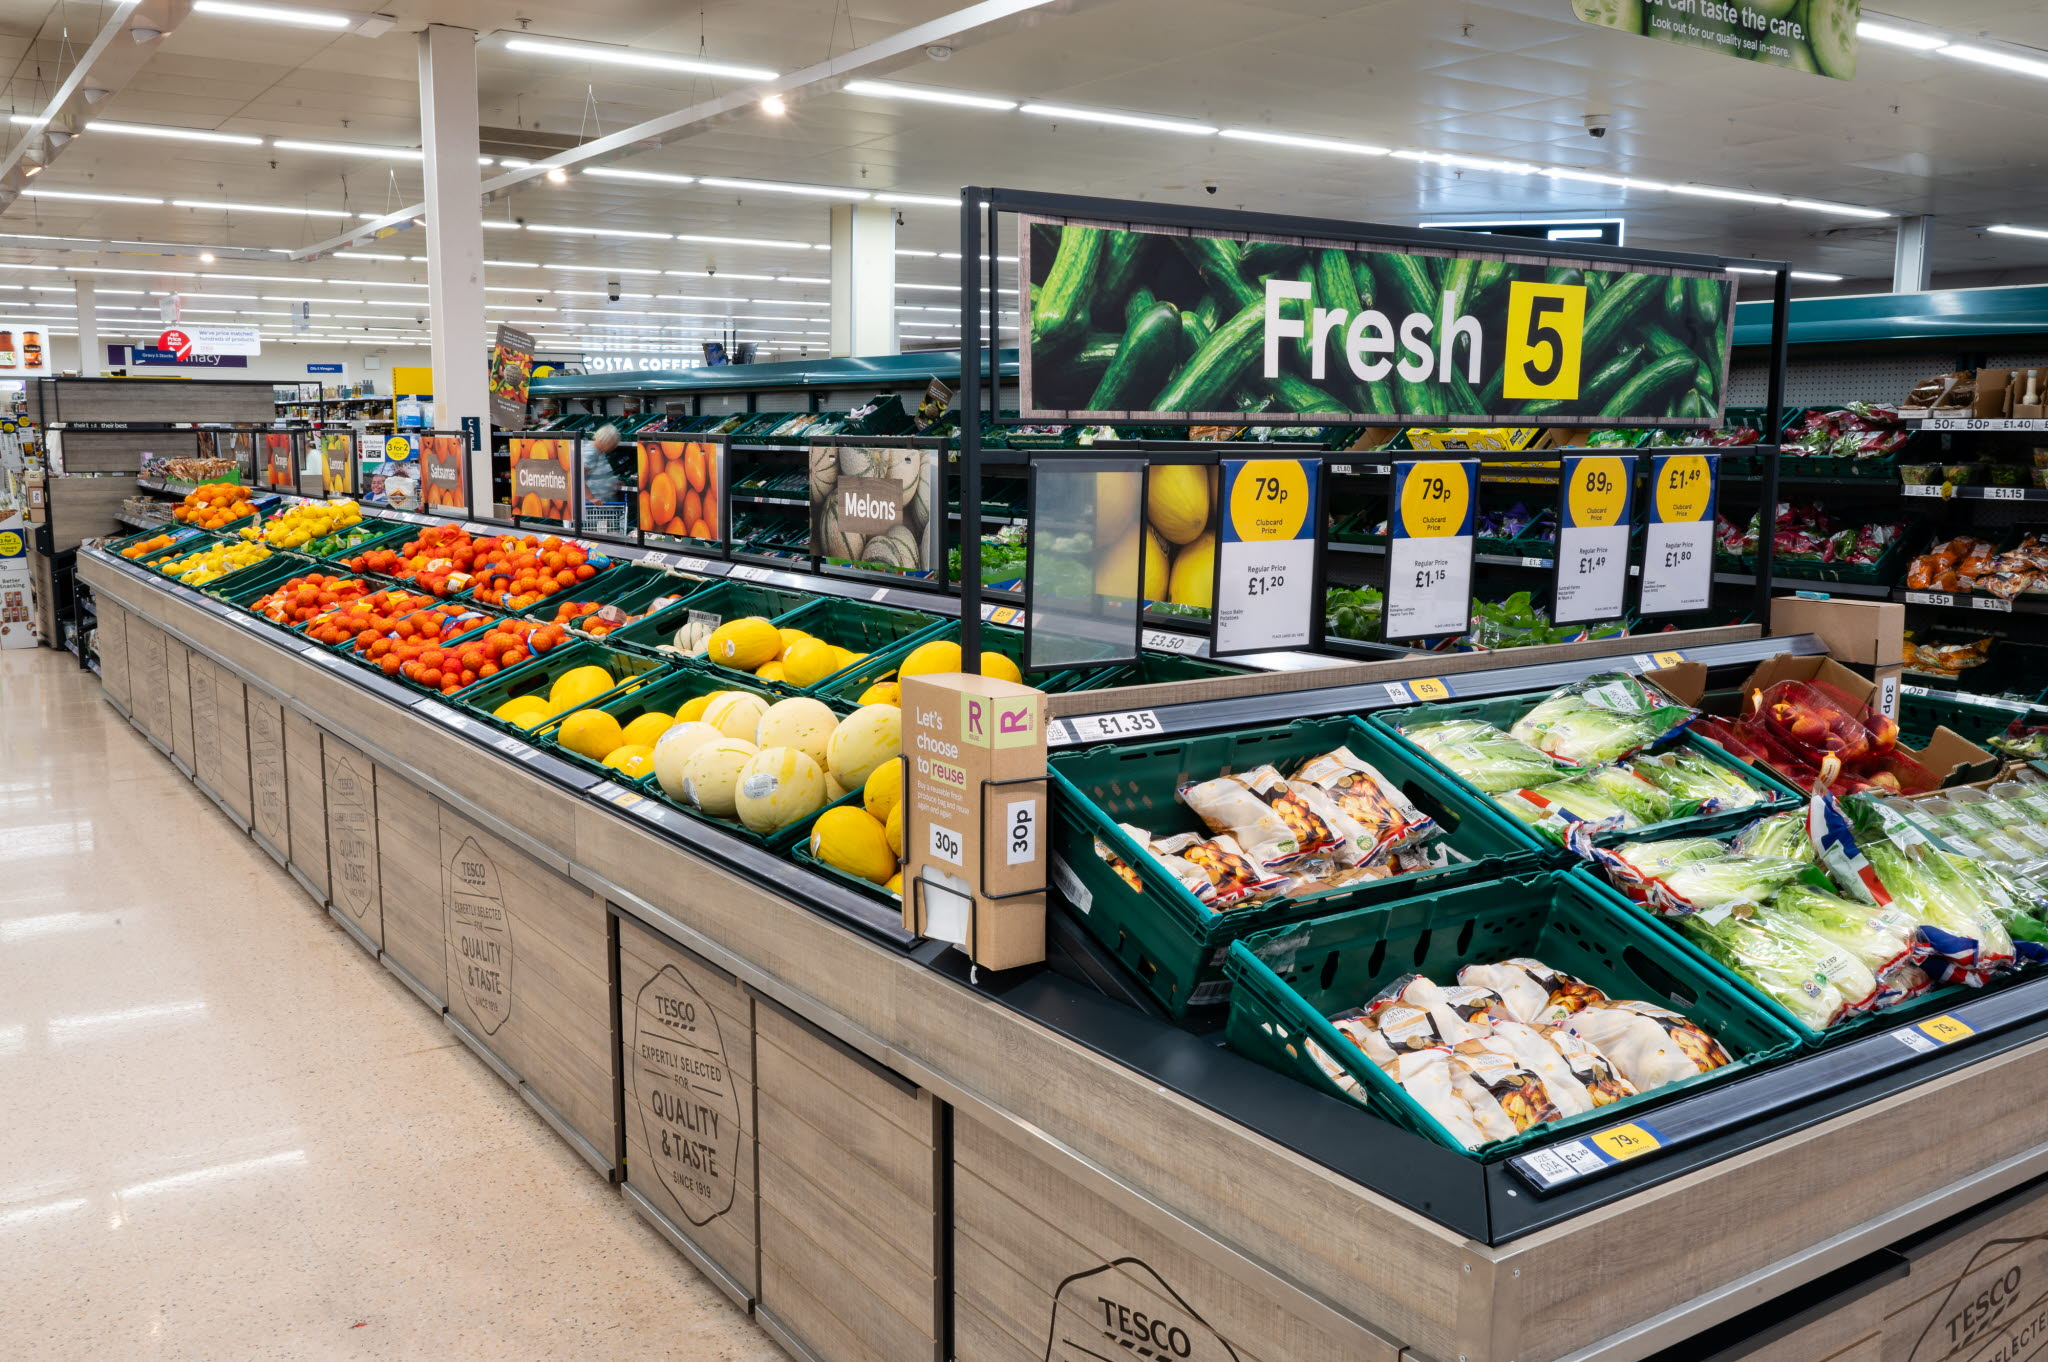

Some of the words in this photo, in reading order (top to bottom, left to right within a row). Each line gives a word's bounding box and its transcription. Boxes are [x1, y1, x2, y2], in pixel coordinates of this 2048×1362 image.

[1668, 0, 1695, 14] can
[1701, 1, 1738, 25] taste
[1742, 8, 1766, 31] the
[1769, 17, 1806, 41] care.
[1652, 15, 1672, 30] Look
[1673, 21, 1687, 34] out
[1688, 23, 1700, 37] for
[1701, 29, 1715, 41] our
[1716, 30, 1742, 49] quality
[1743, 38, 1758, 51] seal
[1759, 40, 1791, 58] in-store.
[1263, 279, 1483, 385] Fresh
[1522, 295, 1565, 387] 5
[583, 357, 634, 372] COSTA
[638, 358, 701, 371] COFFEE
[1967, 420, 1990, 430] 50p
[2004, 420, 2031, 429] £1.40
[366, 450, 381, 458] F&F
[403, 443, 408, 451] 2
[329, 457, 344, 470] Lemons
[430, 464, 455, 480] Satsumas
[519, 469, 566, 490] Clementines
[1586, 472, 1613, 494] 89p
[1669, 469, 1701, 490] £1.49
[1255, 477, 1288, 504] 79p
[1422, 478, 1451, 502] 79p
[1995, 489, 2022, 499] £1.15
[844, 492, 896, 521] Melons
[1586, 507, 1607, 515] Clubcard
[1673, 503, 1692, 511] Clubcard
[1256, 518, 1283, 526] Clubcard
[1422, 516, 1446, 524] Clubcard
[1248, 565, 1269, 573] Regular
[1271, 564, 1286, 572] Price
[1579, 557, 1606, 574] £1.49
[1665, 551, 1692, 568] £1.80
[1248, 576, 1284, 596] £1.20
[1415, 569, 1446, 588] £1.15
[1928, 594, 1950, 605] 55p
[1148, 633, 1185, 650] £3.50
[1420, 683, 1438, 693] 69p
[1884, 685, 1894, 714] 30p
[916, 706, 943, 731] Let's
[969, 700, 983, 735] R
[1000, 707, 1028, 733] R
[1098, 713, 1156, 735] £1.35
[917, 732, 958, 759] choose
[917, 756, 930, 774] to
[932, 764, 964, 785] reuse
[917, 780, 926, 790] Buy
[930, 786, 950, 797] reusable
[917, 792, 937, 803] produce
[937, 797, 947, 808] bag
[947, 802, 956, 810] and
[930, 806, 939, 814] and
[1012, 809, 1032, 853] 30p
[935, 831, 958, 860] 30p
[461, 861, 485, 878] TESCO
[454, 901, 476, 916] EXPERTLY
[477, 906, 502, 921] SELECTED
[461, 936, 501, 966] QUALITY
[468, 965, 475, 986] &
[475, 967, 502, 995] TASTE
[655, 995, 696, 1023] TESCO
[642, 1044, 679, 1068] EXPERTLY
[681, 1056, 722, 1082] SELECTED
[674, 1074, 689, 1089] FOR
[652, 1090, 719, 1140] QUALITY
[1610, 1134, 1640, 1148] 79p
[662, 1129, 672, 1158] &
[673, 1133, 719, 1178] TASTE
[1533, 1154, 1551, 1165] 02E
[1564, 1148, 1589, 1164] £1.20
[1540, 1160, 1563, 1173] 01A
[673, 1171, 694, 1191] SINCE
[695, 1178, 711, 1198] 1919
[1945, 1265, 2021, 1343] TESCO
[1098, 1296, 1192, 1359] TESCO
[1988, 1311, 2048, 1362] ELECTE
